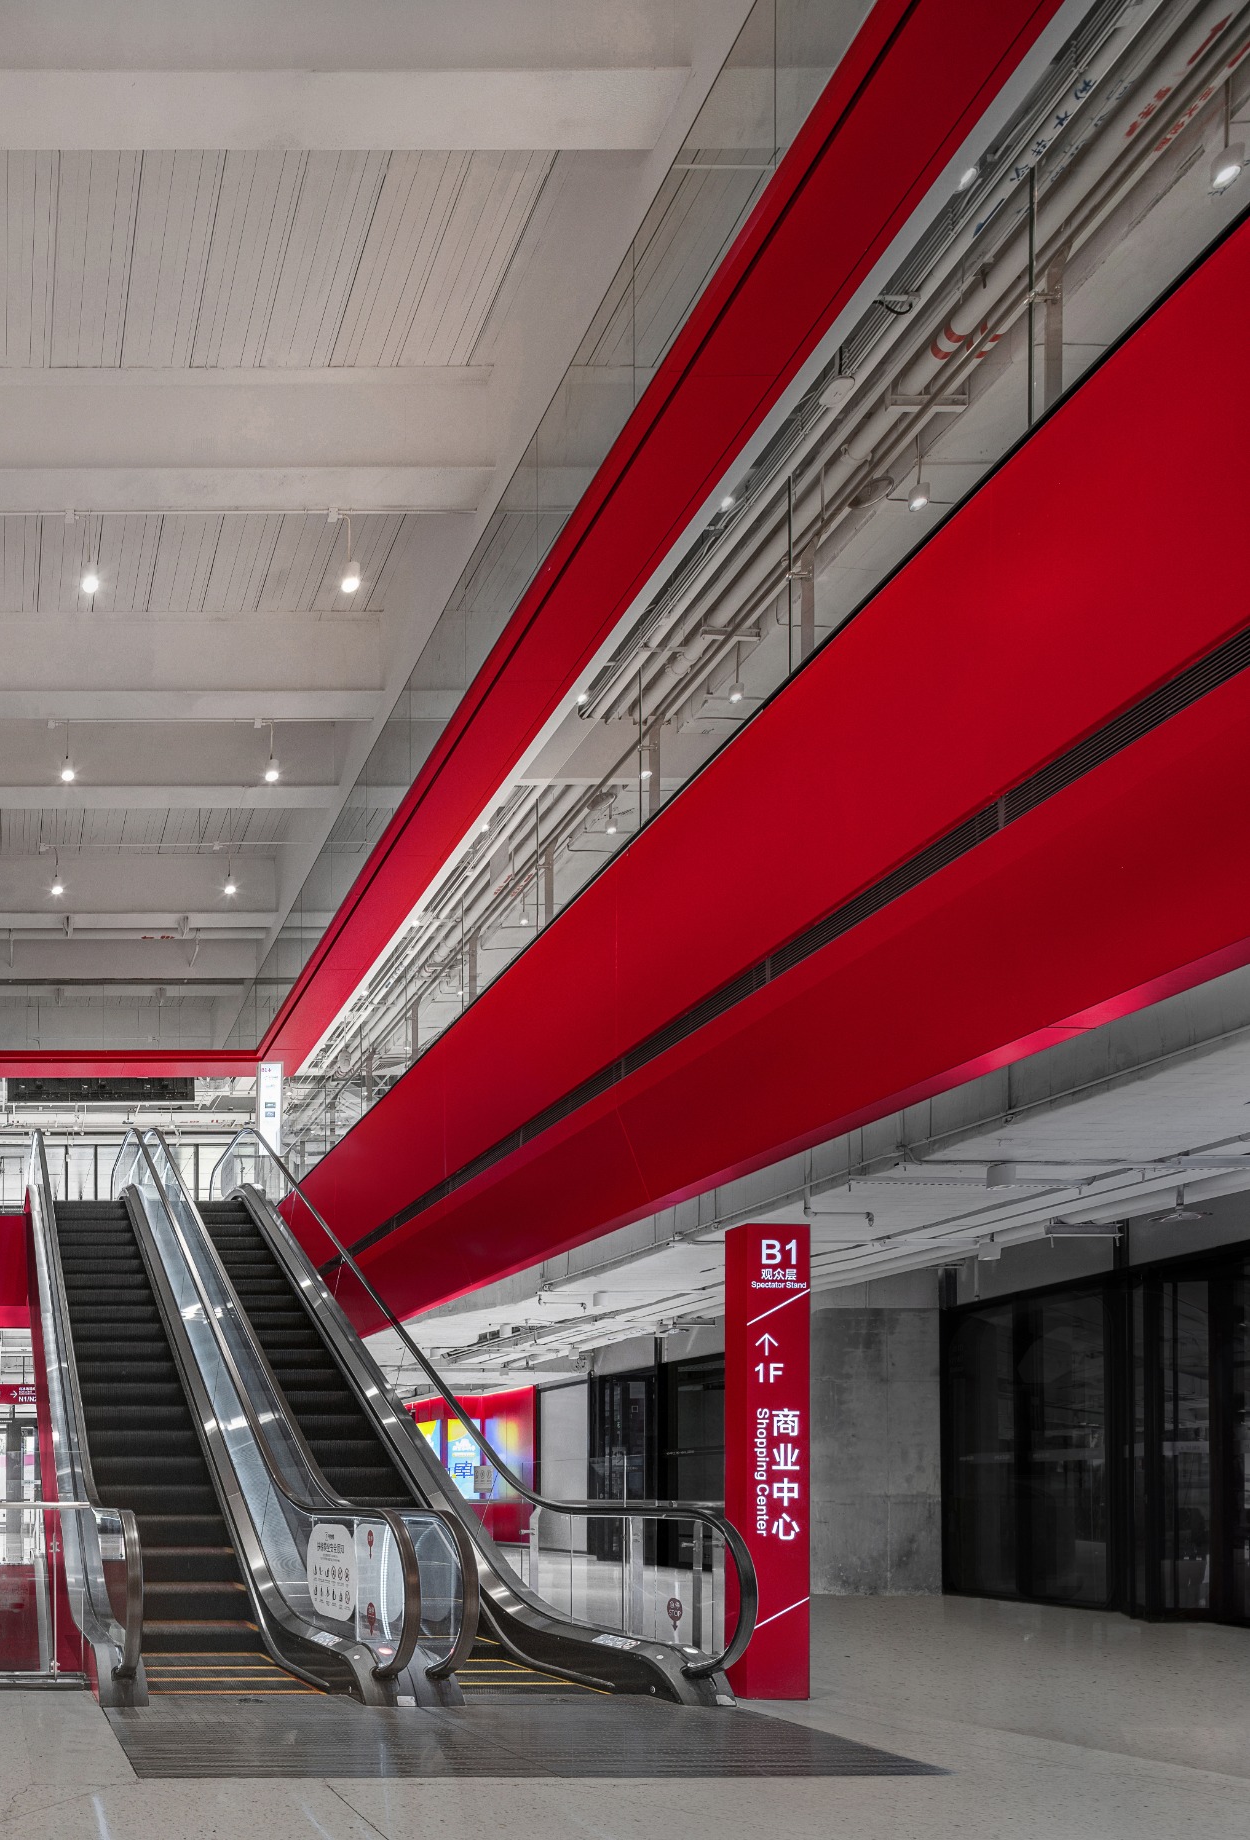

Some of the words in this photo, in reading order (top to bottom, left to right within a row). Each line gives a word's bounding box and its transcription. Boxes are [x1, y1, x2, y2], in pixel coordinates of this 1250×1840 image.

[761, 1239, 797, 1265] B1
[751, 1280, 786, 1290] Spectator
[786, 1281, 807, 1289] Stand
[760, 1268, 797, 1281] 观众层
[754, 1363, 784, 1384] 1F
[755, 1408, 770, 1480] Shopping
[771, 1408, 800, 1541] 商业中心
[755, 1485, 768, 1536] Center
[668, 1609, 682, 1617] STOP
